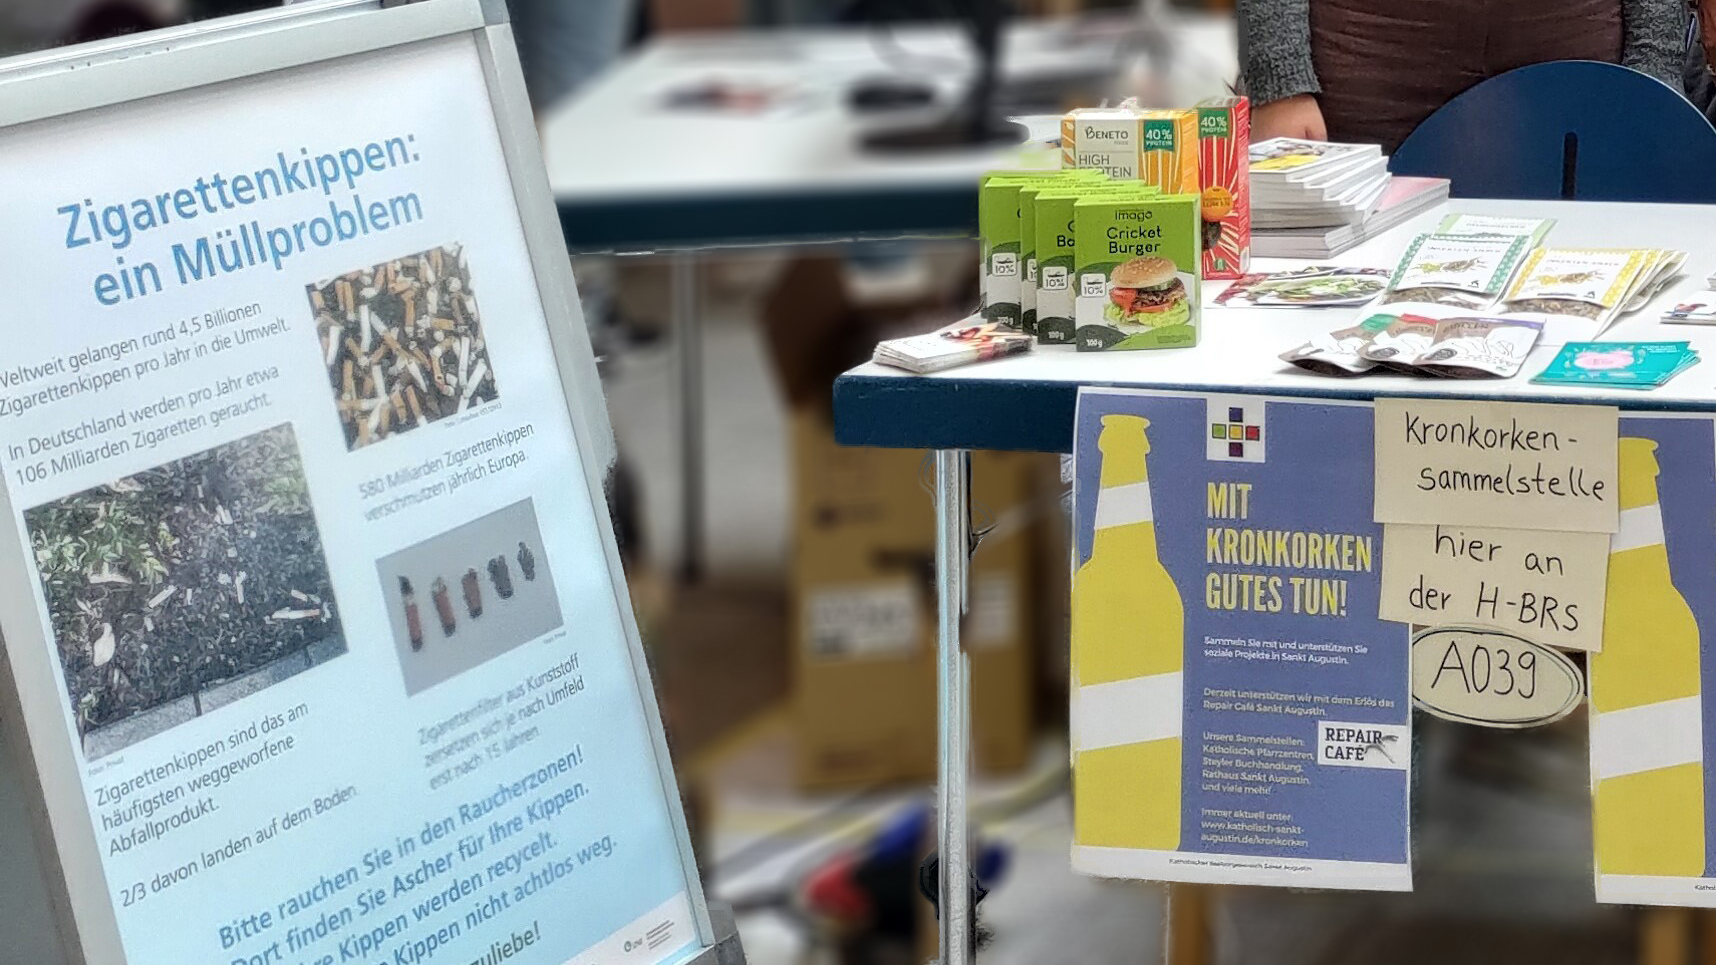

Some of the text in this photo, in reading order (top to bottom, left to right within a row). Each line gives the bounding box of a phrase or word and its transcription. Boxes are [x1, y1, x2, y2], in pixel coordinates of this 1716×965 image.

[1146, 129, 1172, 140] 40%
[1200, 116, 1227, 127] 40%
[1079, 154, 1110, 165] HIGH
[57, 133, 421, 250] Zigarettenkippen:
[94, 192, 424, 306] ein Müllproblem
[1107, 226, 1162, 239] Cricket
[1109, 241, 1161, 256] Burger
[995, 265, 1014, 274] 10%
[1045, 279, 1065, 288] 10%
[1084, 286, 1103, 295] 10%
[69, 338, 139, 375] gelangen
[143, 323, 176, 347] rund
[179, 316, 202, 338] 4,5
[205, 302, 262, 329] Billionen
[0, 317, 292, 417] Zigarettenkippen pro Jahr in die Umwelt.
[8, 365, 279, 461] In Deutschland werden pro Jahr etwa
[16, 461, 47, 486] 106
[51, 437, 130, 476] Milliarden
[134, 414, 206, 450] Zigaretten
[358, 478, 385, 500] 580
[444, 423, 535, 467] Zigarettenkippen
[448, 464, 487, 495] jährlich
[488, 449, 530, 475] Europa.
[1207, 482, 1252, 519] MIT
[1206, 528, 1372, 573] KRONKORKEN
[1434, 524, 1564, 576] hier an
[1206, 572, 1348, 617] GUTES TUN!
[1409, 574, 1579, 632] der H-BRS
[506, 652, 580, 703] aus Kunststoff
[1430, 639, 1537, 699] A039
[518, 676, 585, 720] nach Umfeld
[94, 739, 226, 806] Zigarettenkippen
[229, 724, 258, 750] sind
[261, 715, 285, 734] das
[288, 703, 309, 722] am
[1325, 728, 1383, 744] REPAIR
[1325, 743, 1365, 761] CAFÉ
[102, 735, 294, 832] häufigsten weggeworfene
[109, 797, 220, 857] Abfallprodukt.
[219, 910, 272, 950] Bitte
[278, 866, 358, 921] rauchen
[362, 848, 392, 876] Sie
[396, 837, 415, 858] in
[419, 816, 455, 846] den
[458, 744, 584, 826] Raucherzonen!
[120, 881, 147, 907] 2/3
[151, 860, 199, 894] davon
[201, 836, 252, 868] landen
[256, 818, 279, 844] auf
[282, 807, 312, 831] dem
[286, 782, 590, 954] finden Sie Ascher für Ihre Kippen.
[339, 832, 558, 963] Kippen werden recycelt.
[394, 835, 618, 965] Kippen nicht achtlos weg.
